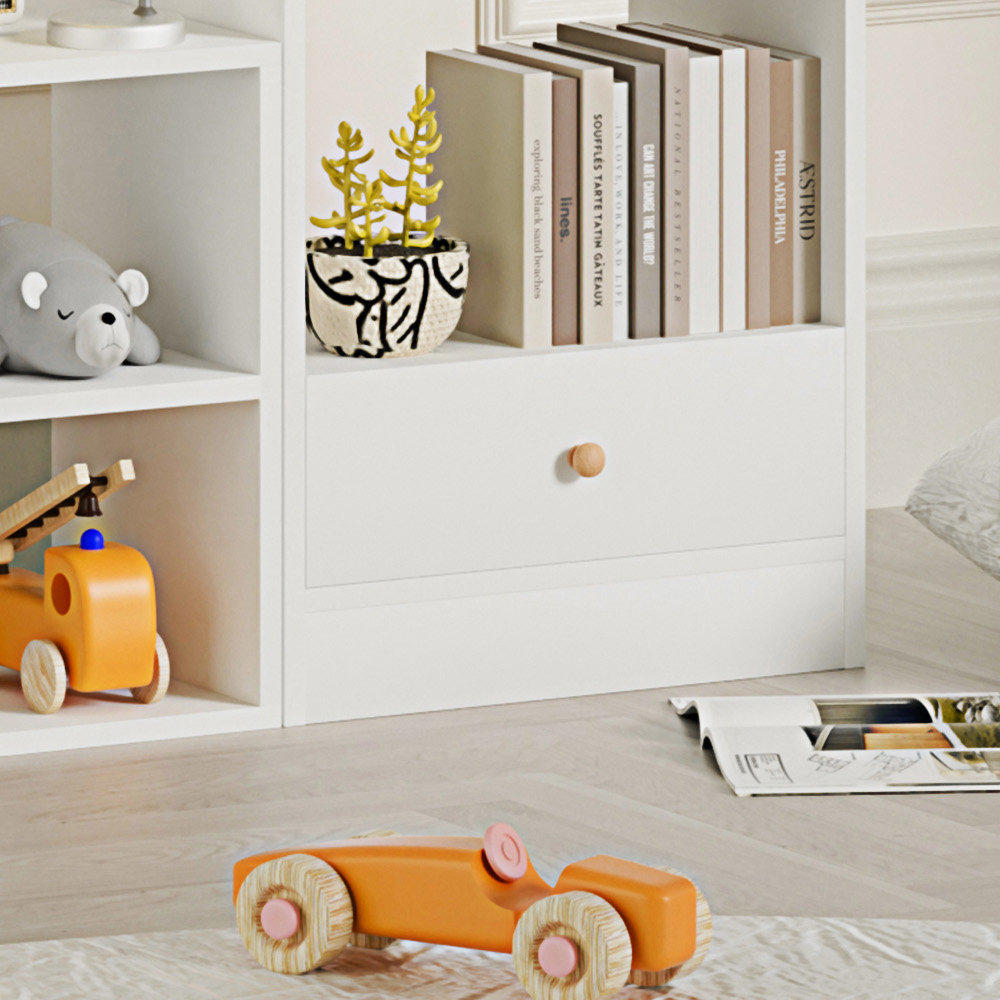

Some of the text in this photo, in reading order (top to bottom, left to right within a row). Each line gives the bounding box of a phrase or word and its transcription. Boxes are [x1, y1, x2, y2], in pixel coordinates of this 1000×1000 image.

[592, 113, 605, 172] SOUFFLÉS
[530, 138, 544, 300] exploring black sand beaches
[560, 196, 573, 243] lines.
[593, 174, 603, 211] TARTE
[593, 213, 603, 248] TATIN
[642, 143, 656, 266] CAN ART CHANGE THE WORLD?
[673, 86, 681, 303] NATIONAL BESTSELLER
[773, 149, 787, 245] PHILADELPHIA
